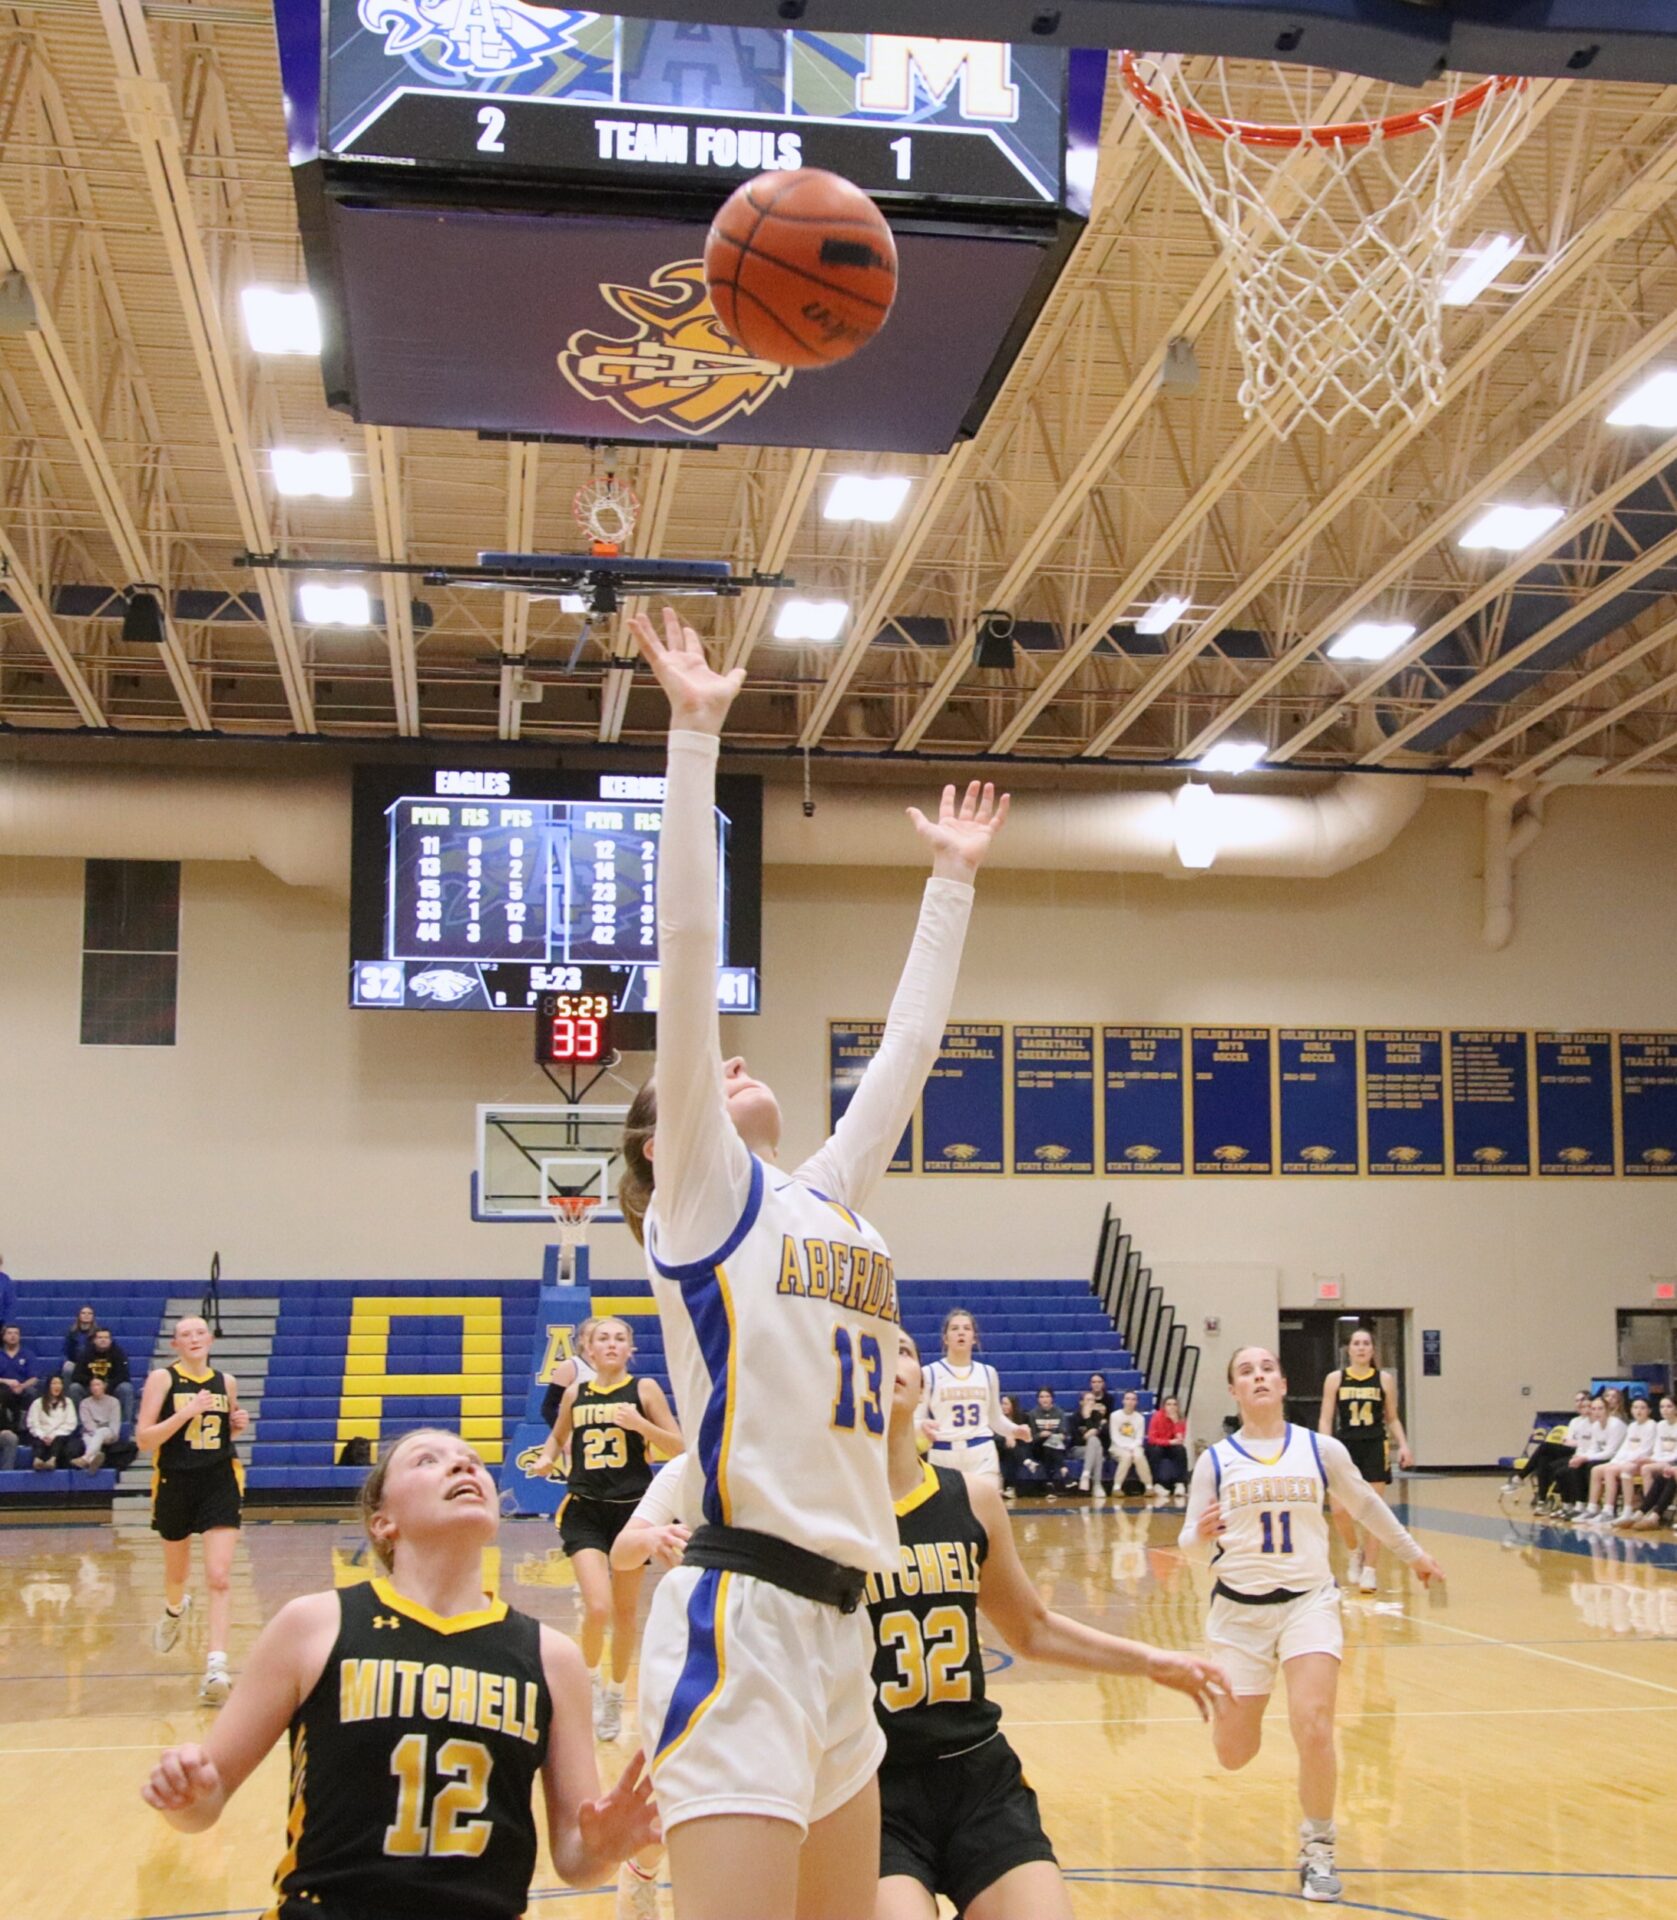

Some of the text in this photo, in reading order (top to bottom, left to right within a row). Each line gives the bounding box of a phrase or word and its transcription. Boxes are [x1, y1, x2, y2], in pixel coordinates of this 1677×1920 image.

[476, 106, 506, 152] 2
[595, 120, 803, 171] TEAM FOULS
[889, 137, 911, 180] 1
[436, 770, 511, 796] EAGLES
[501, 809, 533, 828] PTS
[420, 836, 440, 855] 11
[593, 840, 655, 861] 12 2
[467, 858, 482, 878] 3
[509, 859, 524, 879] 2
[593, 861, 654, 882] 14 1
[467, 880, 481, 900] 2
[509, 881, 523, 901] 5
[591, 882, 654, 903] 23 1
[468, 902, 480, 921] 1
[504, 903, 527, 922] 12
[591, 904, 654, 924] 32 3
[416, 922, 441, 942] 44
[466, 923, 481, 943] 3
[591, 925, 654, 945] 42 2
[359, 966, 402, 999] 32
[530, 966, 582, 990] 5:23
[716, 973, 749, 1005] 41
[557, 995, 608, 1018] 5:23
[553, 1019, 598, 1057] 33
[940, 1049, 995, 1059] ASKETBALL
[777, 1234, 899, 1324] ABERDE
[830, 1321, 885, 1440] 13
[952, 1403, 981, 1428] 33
[1349, 1401, 1374, 1426] 14
[184, 1414, 223, 1450] 42
[582, 1427, 628, 1470] 23
[1259, 1510, 1294, 1555] 11
[879, 1605, 972, 1713] 32
[339, 1658, 540, 1745] MITCHELL
[383, 1733, 494, 1857] 12
